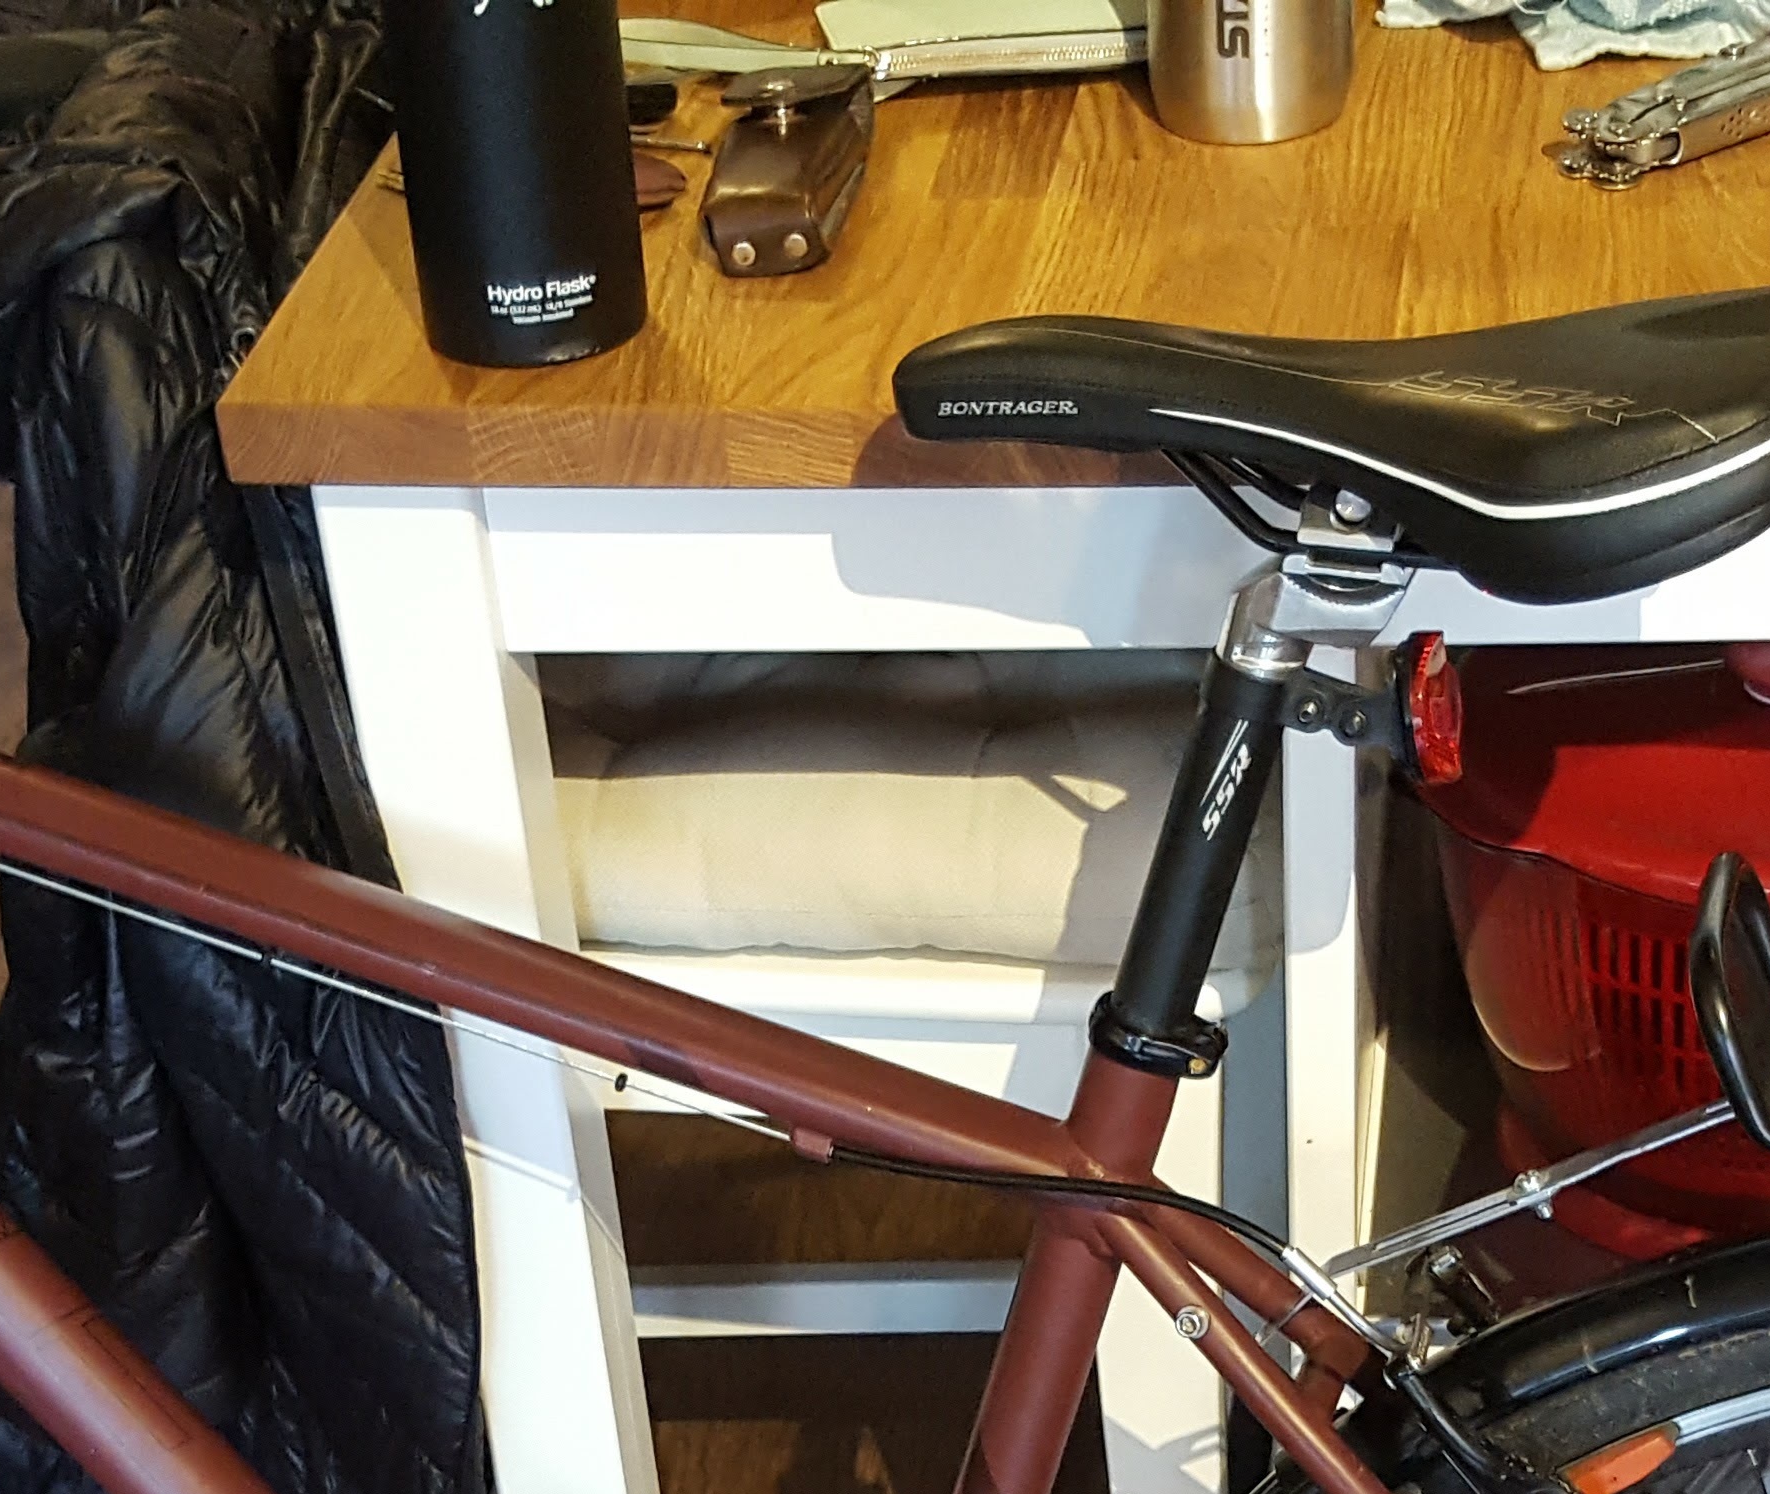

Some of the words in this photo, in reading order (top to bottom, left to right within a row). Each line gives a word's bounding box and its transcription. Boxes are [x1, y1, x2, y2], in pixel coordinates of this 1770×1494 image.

[1215, 0, 1250, 59] ST
[487, 284, 544, 305] Hydro
[937, 400, 1079, 416] BONTRAGER
[1202, 742, 1253, 841] SSR
